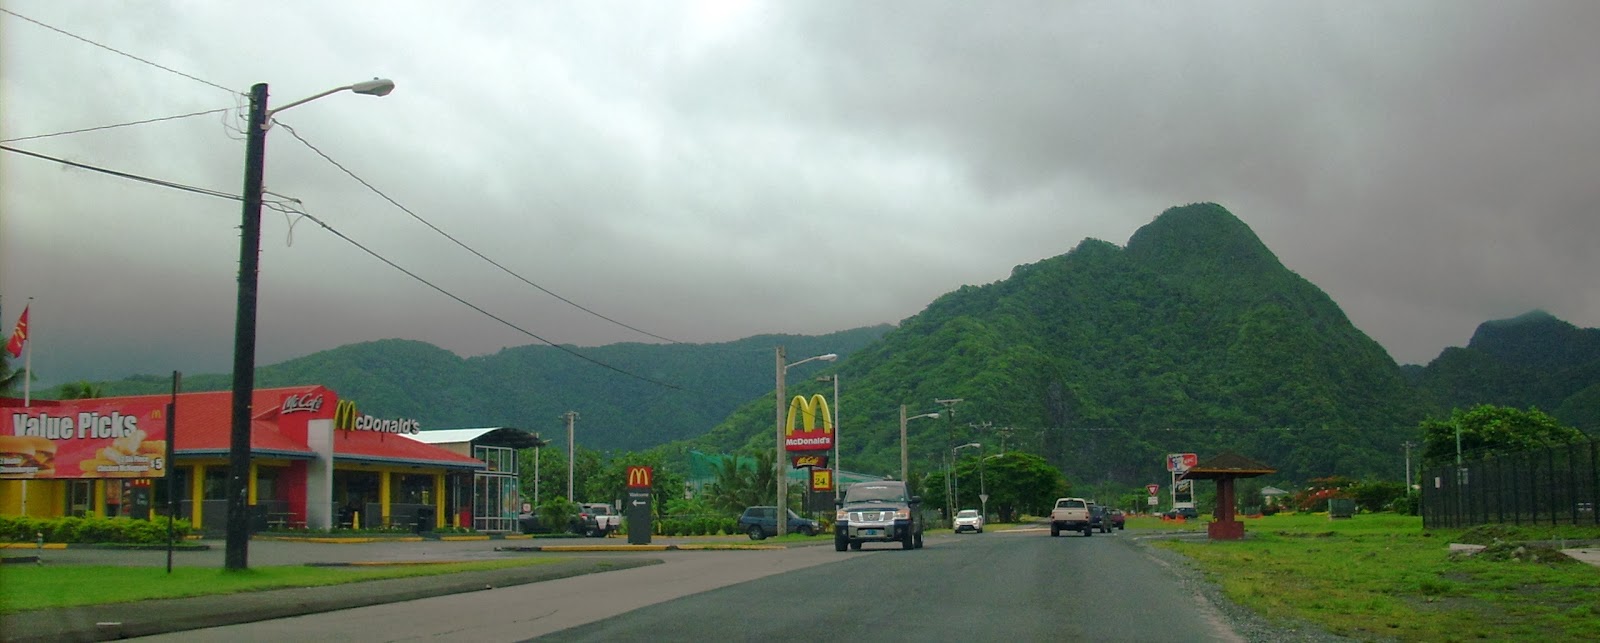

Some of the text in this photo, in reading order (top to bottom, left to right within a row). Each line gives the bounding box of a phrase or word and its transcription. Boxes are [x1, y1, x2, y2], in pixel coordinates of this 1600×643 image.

[13, 411, 137, 439] Value Picks
[334, 400, 421, 434] McDonald's
[786, 437, 831, 446] McDonald's
